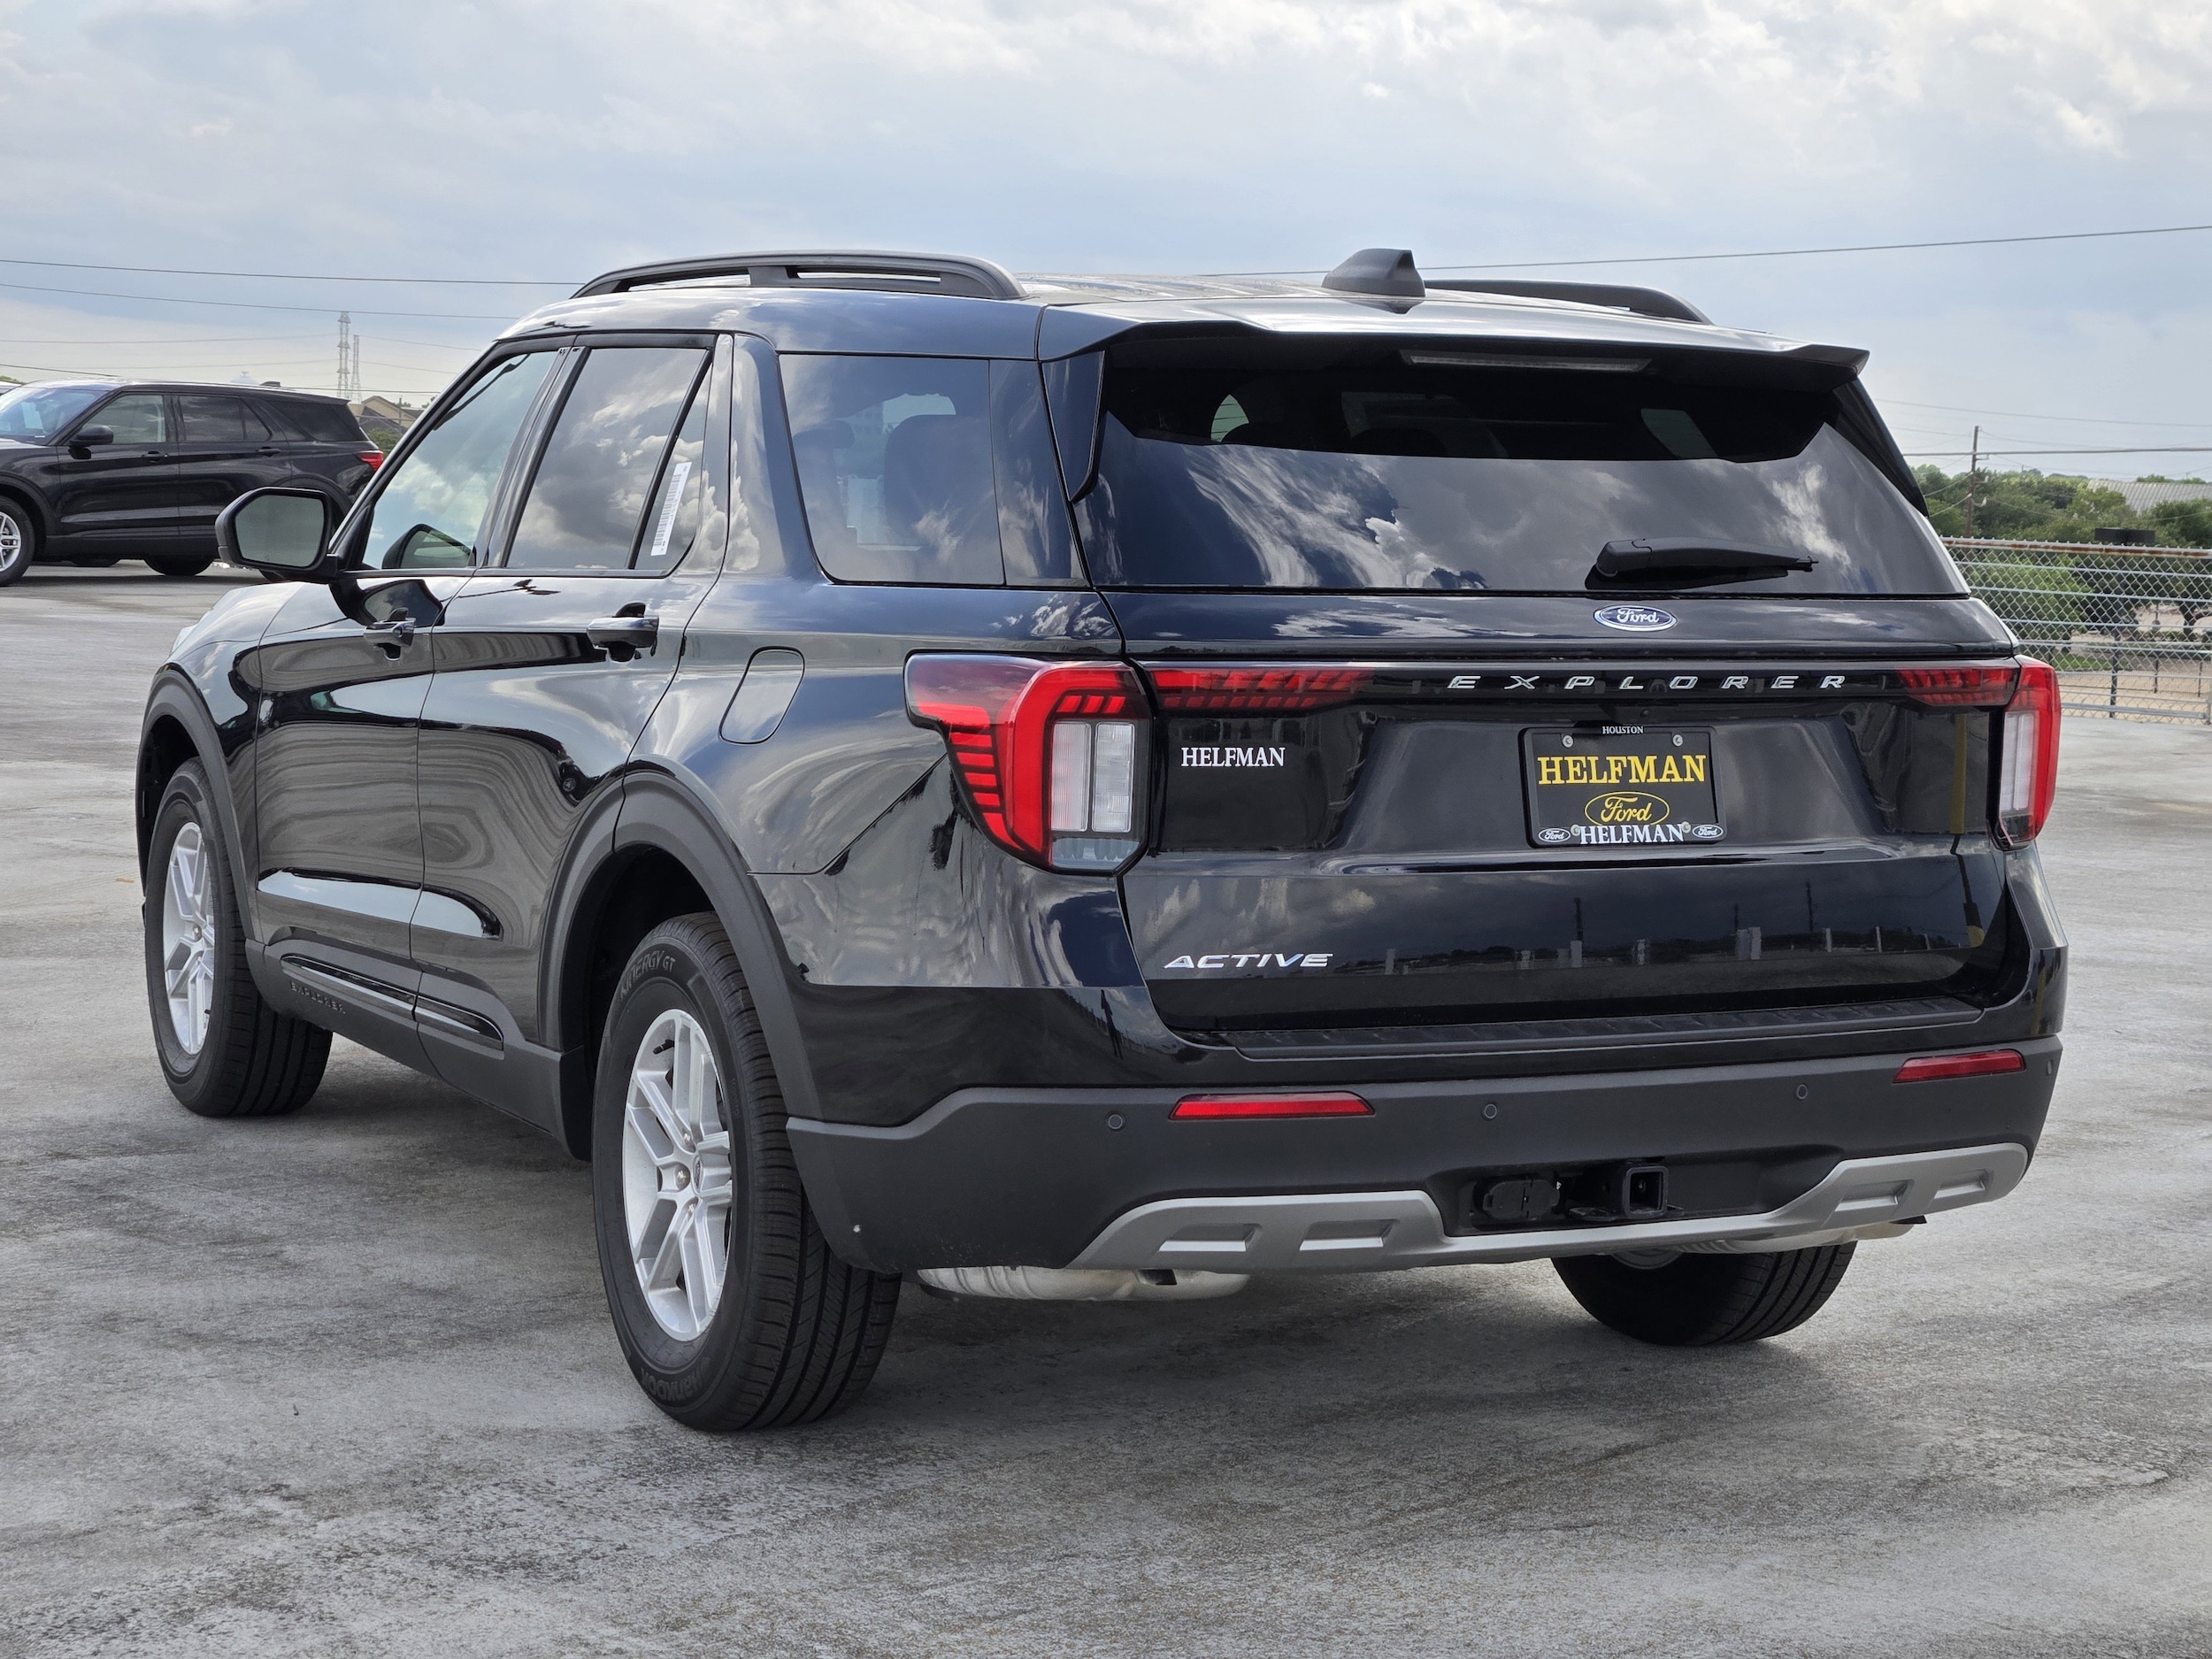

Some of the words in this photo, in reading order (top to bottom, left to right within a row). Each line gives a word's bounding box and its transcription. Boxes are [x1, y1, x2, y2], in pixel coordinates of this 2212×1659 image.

[1617, 607, 1660, 623] Ford
[1447, 675, 1846, 690] EXPLORER
[1601, 726, 1644, 734] HOUSTON
[1180, 747, 1286, 767] HELFMAN
[1537, 755, 1706, 784] HELFMAN
[1600, 796, 1652, 822] Ford
[1579, 824, 1685, 844] HELFMAN
[1164, 953, 1333, 969] ACTIVE
